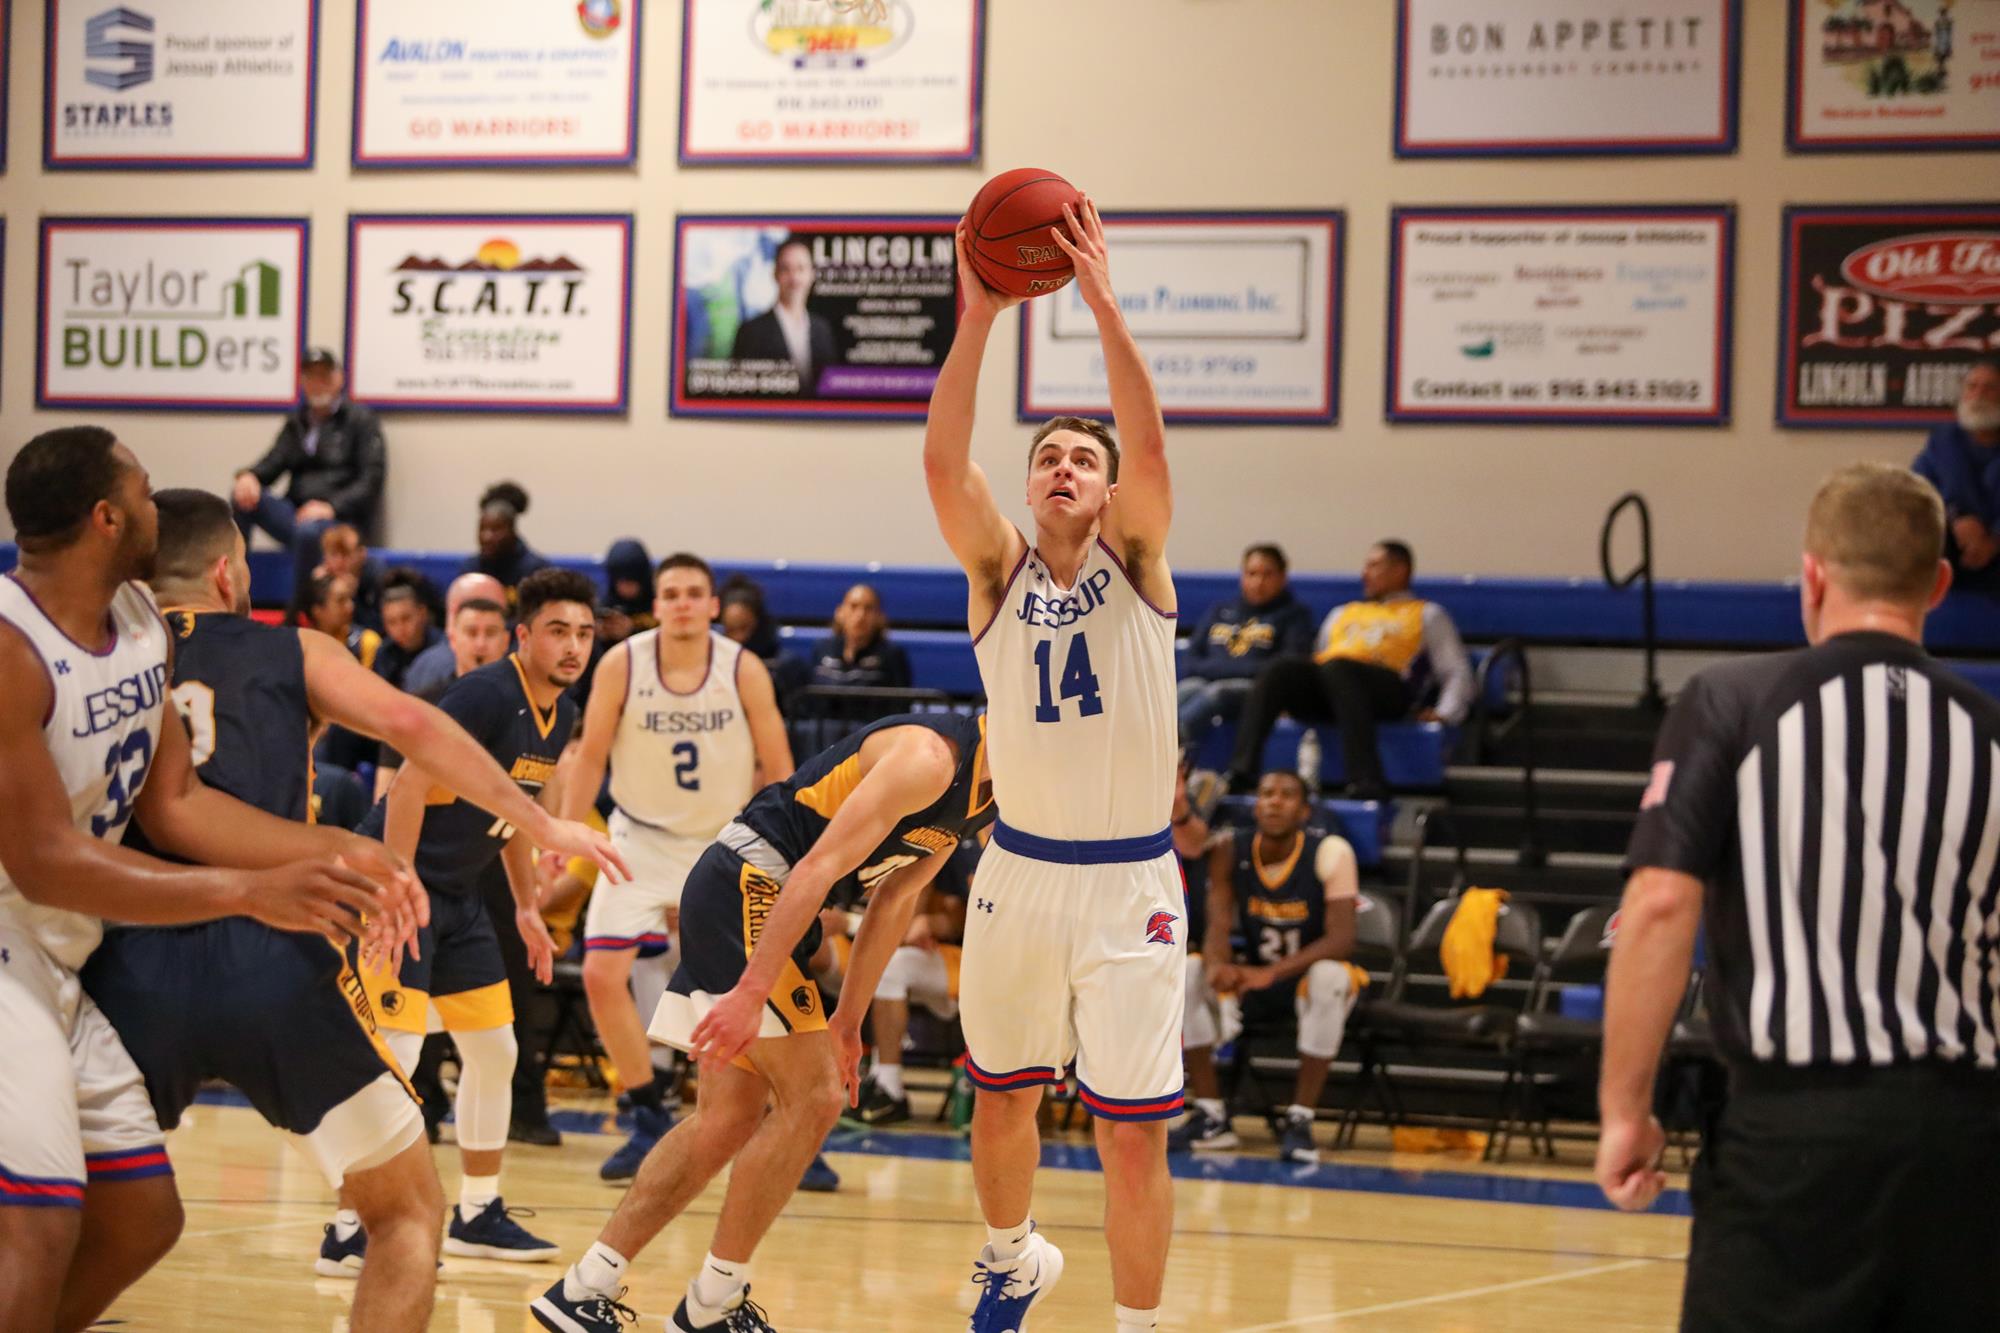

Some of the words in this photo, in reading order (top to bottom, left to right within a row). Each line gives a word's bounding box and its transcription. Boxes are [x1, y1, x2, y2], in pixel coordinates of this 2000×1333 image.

[165, 35, 210, 49] Proud
[214, 38, 272, 52] sponsor
[278, 34, 295, 49] of
[1430, 23, 1504, 54] BON
[165, 60, 217, 77] Jessup
[223, 58, 294, 74] Athletics
[64, 103, 173, 128] STAPLES
[408, 118, 443, 138] GO
[737, 121, 773, 140] GO
[812, 235, 954, 268] LINCOLN
[1866, 243, 1942, 282] Old
[65, 258, 208, 317] Taylor
[391, 279, 588, 316] S.C.A.T.T.
[1801, 273, 2000, 350] PIZ
[63, 325, 281, 373] BUILDers
[1413, 379, 1503, 399] Contact
[1016, 568, 1111, 629] JESSUP
[1034, 631, 1104, 723] 14
[73, 662, 168, 739] JESSUP
[639, 709, 734, 734] JESSUP
[671, 741, 700, 791] 2
[1257, 927, 1301, 963] 21
